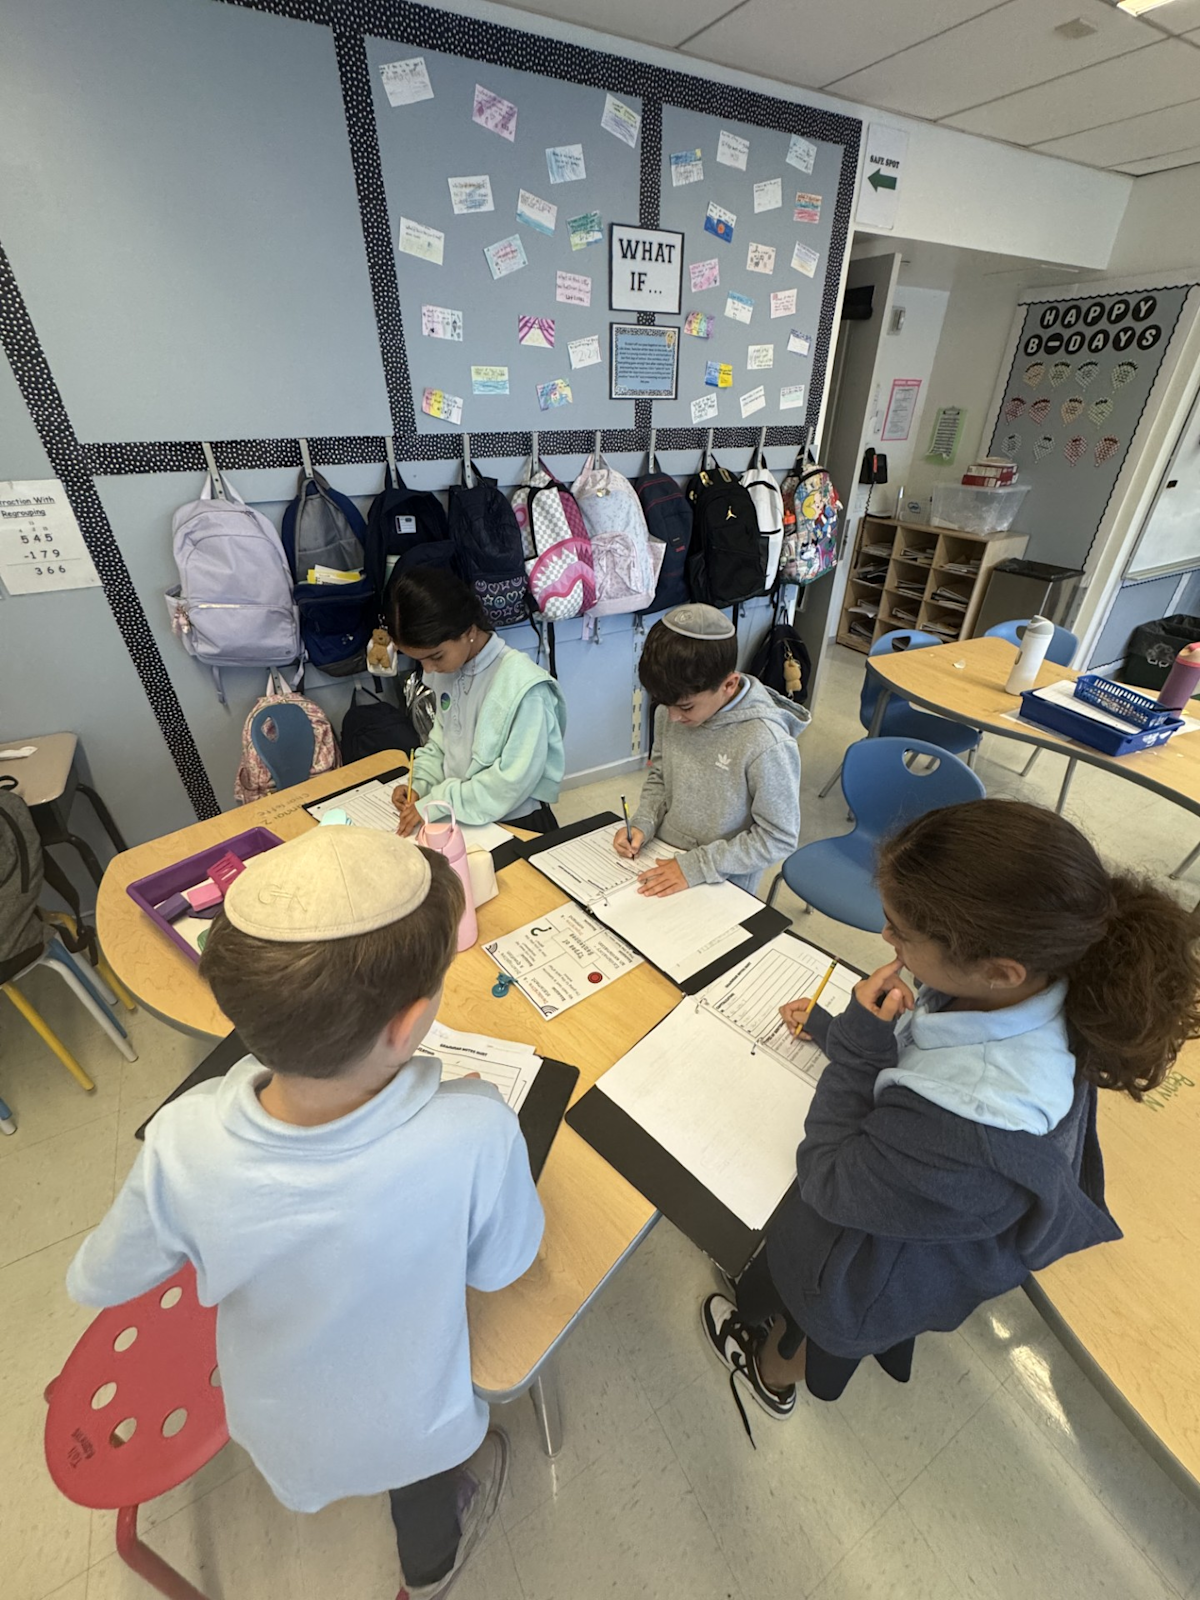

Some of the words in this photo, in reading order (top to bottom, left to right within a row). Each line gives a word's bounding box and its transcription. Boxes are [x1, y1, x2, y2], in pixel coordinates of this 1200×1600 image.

[870, 155, 884, 165] SAFE
[885, 158, 900, 169] SPOT
[619, 238, 676, 264] WHAT
[630, 272, 662, 294] IF...
[1042, 297, 1155, 327] HAPPY
[1026, 327, 1158, 354] B-DAYS
[1, 509, 46, 518] Regrouping
[567, 933, 594, 955] Sentences
[567, 944, 585, 958] Types
